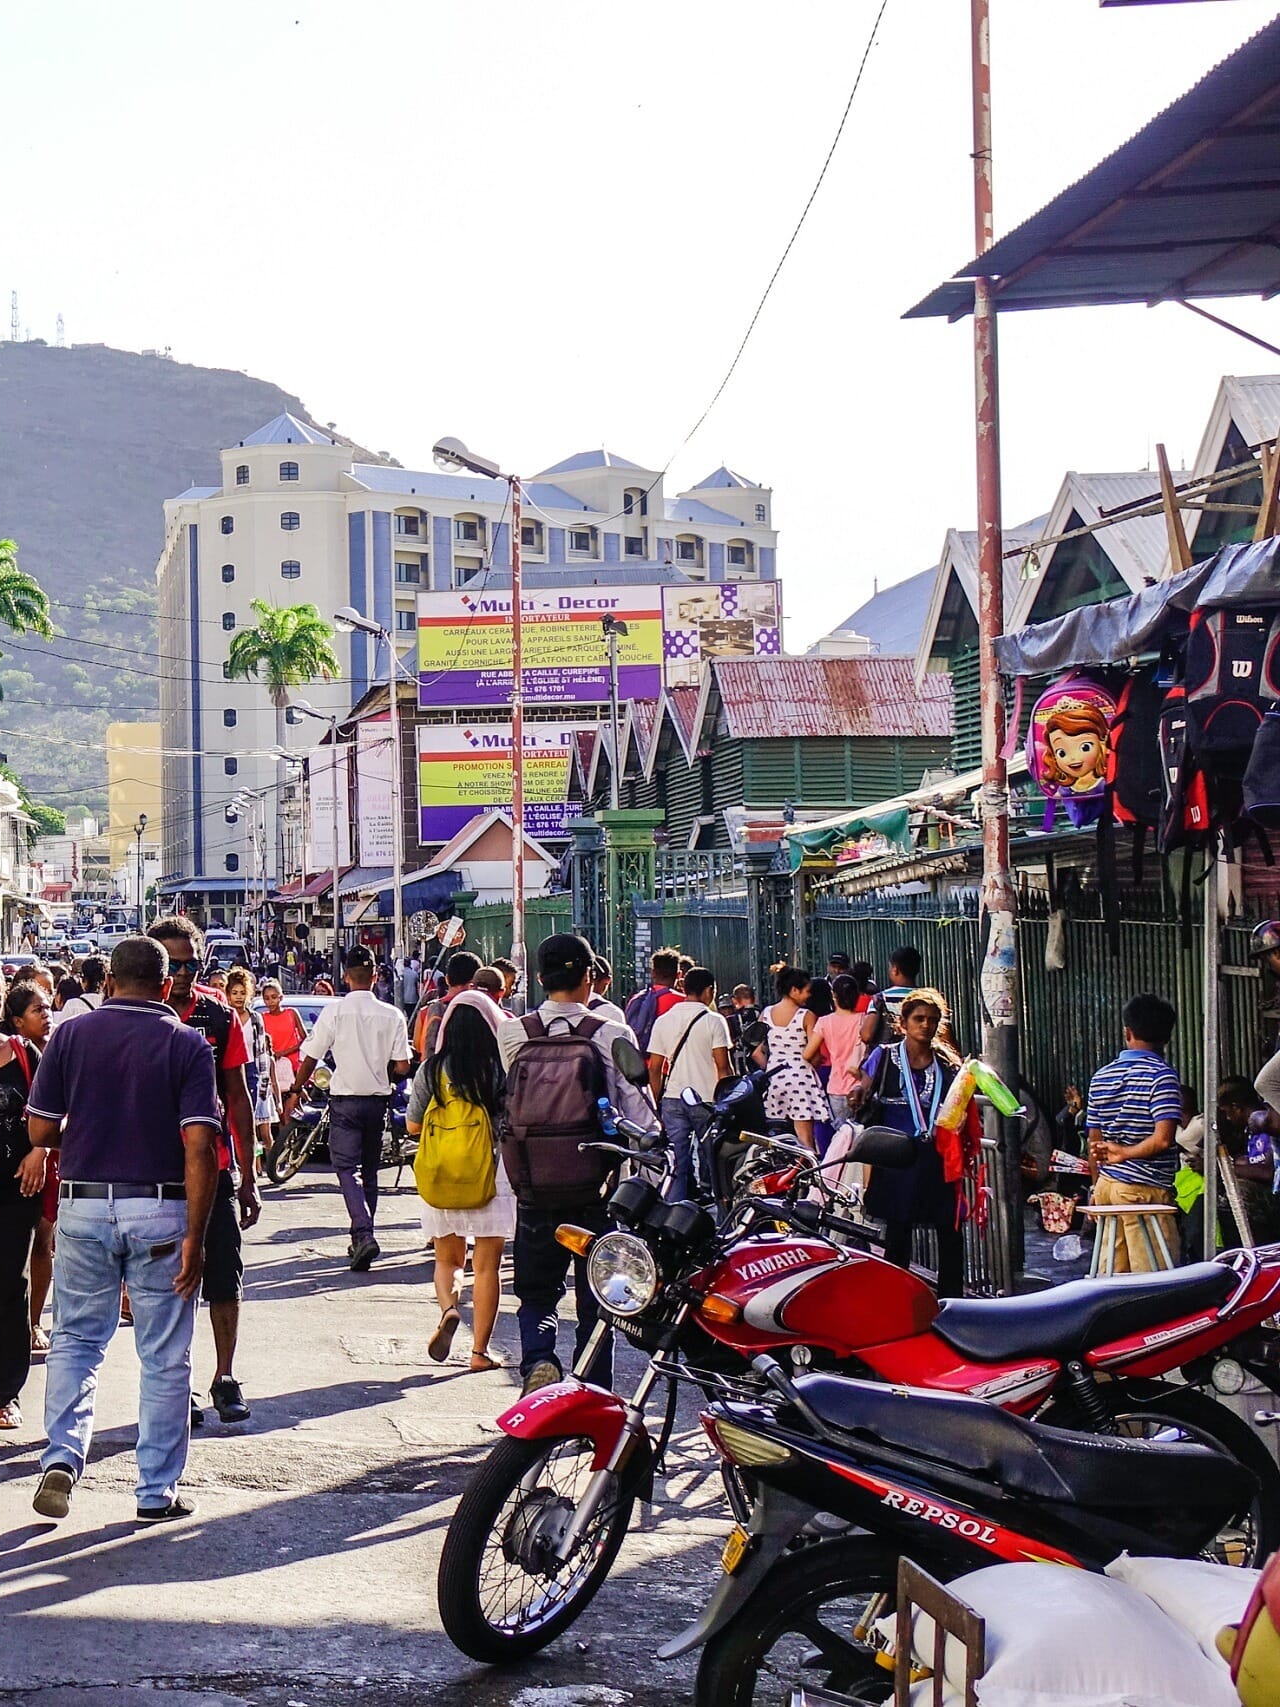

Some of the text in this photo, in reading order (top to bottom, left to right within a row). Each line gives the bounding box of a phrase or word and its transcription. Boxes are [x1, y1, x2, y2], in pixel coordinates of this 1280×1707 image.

[480, 599, 535, 612] Muti
[558, 596, 620, 609] Decor
[1236, 614, 1263, 624] Wilson
[443, 628, 487, 636] CARREAUX
[466, 638, 488, 646] POUR
[527, 635, 571, 643] APPAREILS
[573, 634, 602, 642] SANITA
[562, 667, 600, 676] CUREPIPE
[549, 684, 565, 692] 1701
[482, 735, 537, 747] Muti
[453, 763, 503, 771] PROMOTION
[526, 760, 568, 769] CARREAU
[529, 770, 558, 778] RENDRE
[458, 789, 467, 797] ET
[469, 788, 511, 796] CHOISSISEZ
[534, 803, 563, 812] CAILLE,
[529, 812, 561, 820] L'ÉGLISE
[536, 821, 549, 829] 676
[735, 1247, 812, 1281] YAMAHA
[611, 1315, 644, 1338] YAMAHA
[880, 1490, 997, 1544] REPSOL
